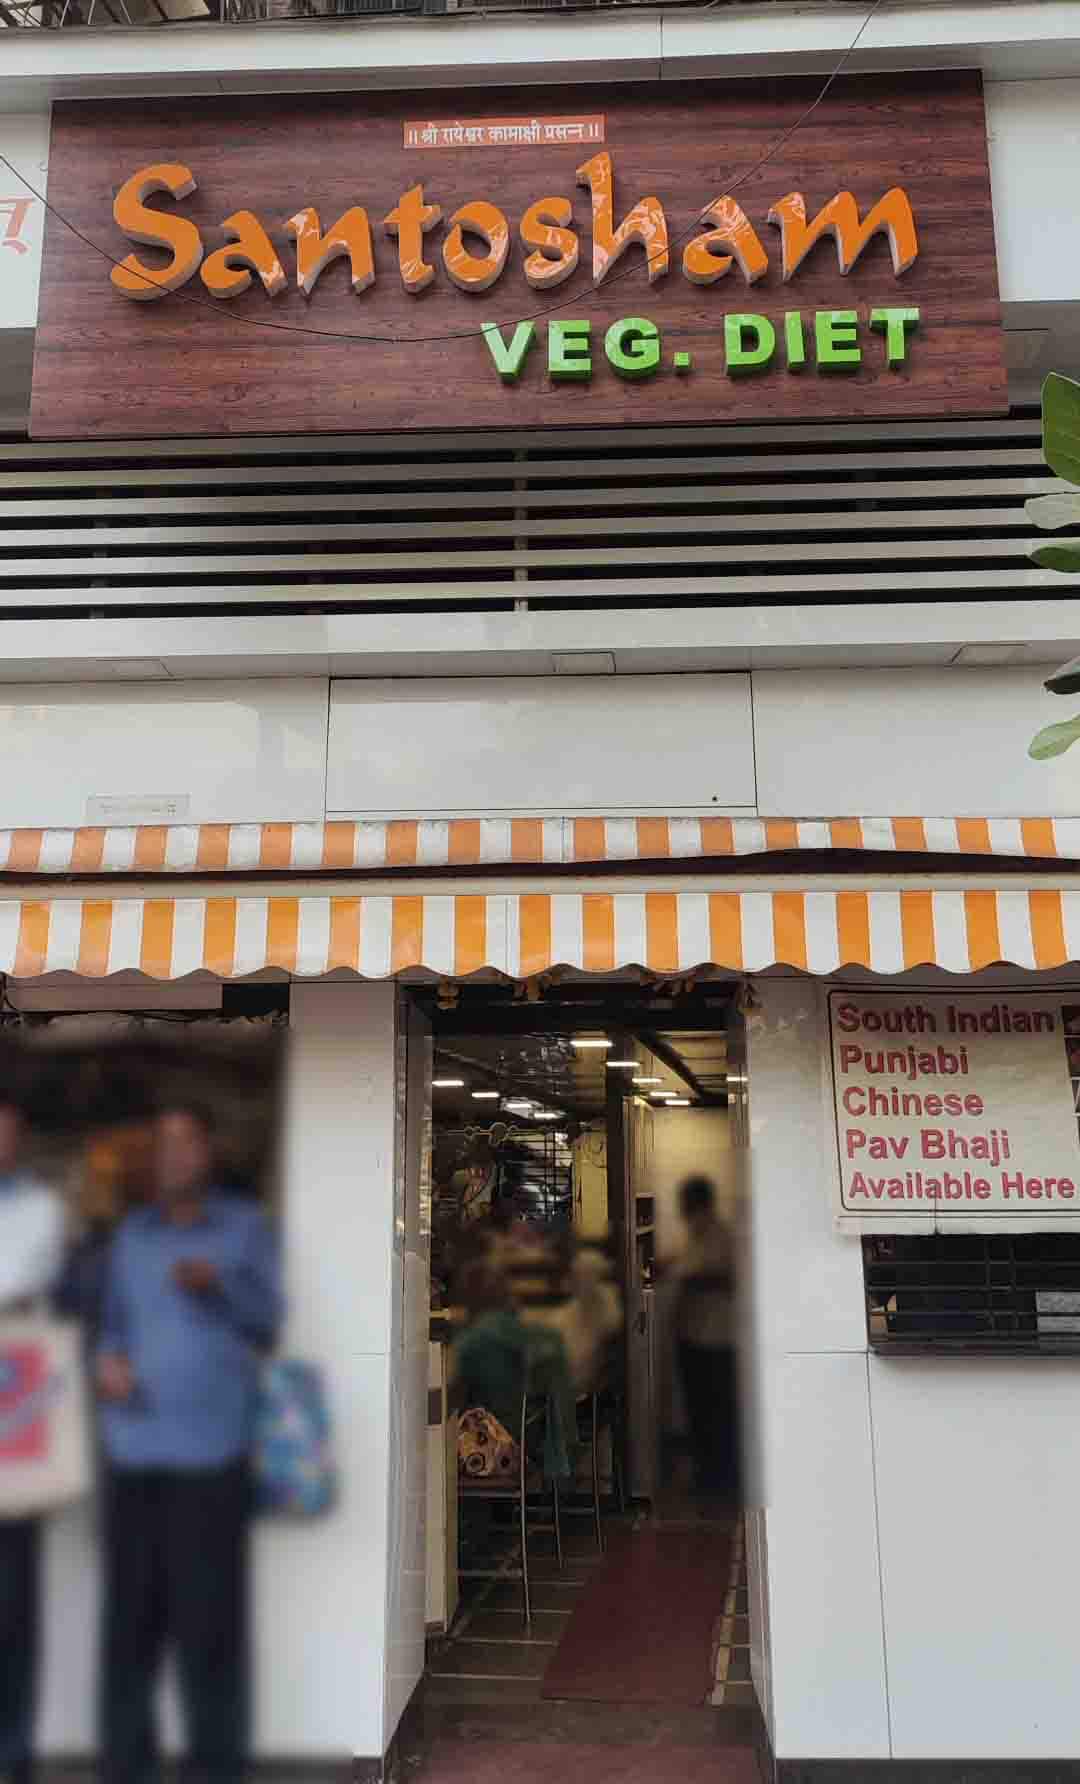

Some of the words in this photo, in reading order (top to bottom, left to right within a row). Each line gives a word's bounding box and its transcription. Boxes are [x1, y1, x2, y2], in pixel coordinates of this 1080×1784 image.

[420, 122, 439, 144] श्री
[487, 119, 542, 144] कामाक्षी
[543, 123, 585, 140] प्रसन्न
[110, 152, 918, 300] Santosham
[480, 317, 692, 381] VEG.
[722, 307, 920, 376] DIET
[837, 1004, 937, 1033] South
[946, 1004, 1055, 1034] Indian
[839, 1044, 969, 1081] Punjabi
[842, 1086, 984, 1117] Chinese
[846, 1129, 910, 1160] Pav
[920, 1128, 1011, 1167] Bhaji
[848, 1171, 992, 1200] Available
[1001, 1171, 1075, 1200] Here
